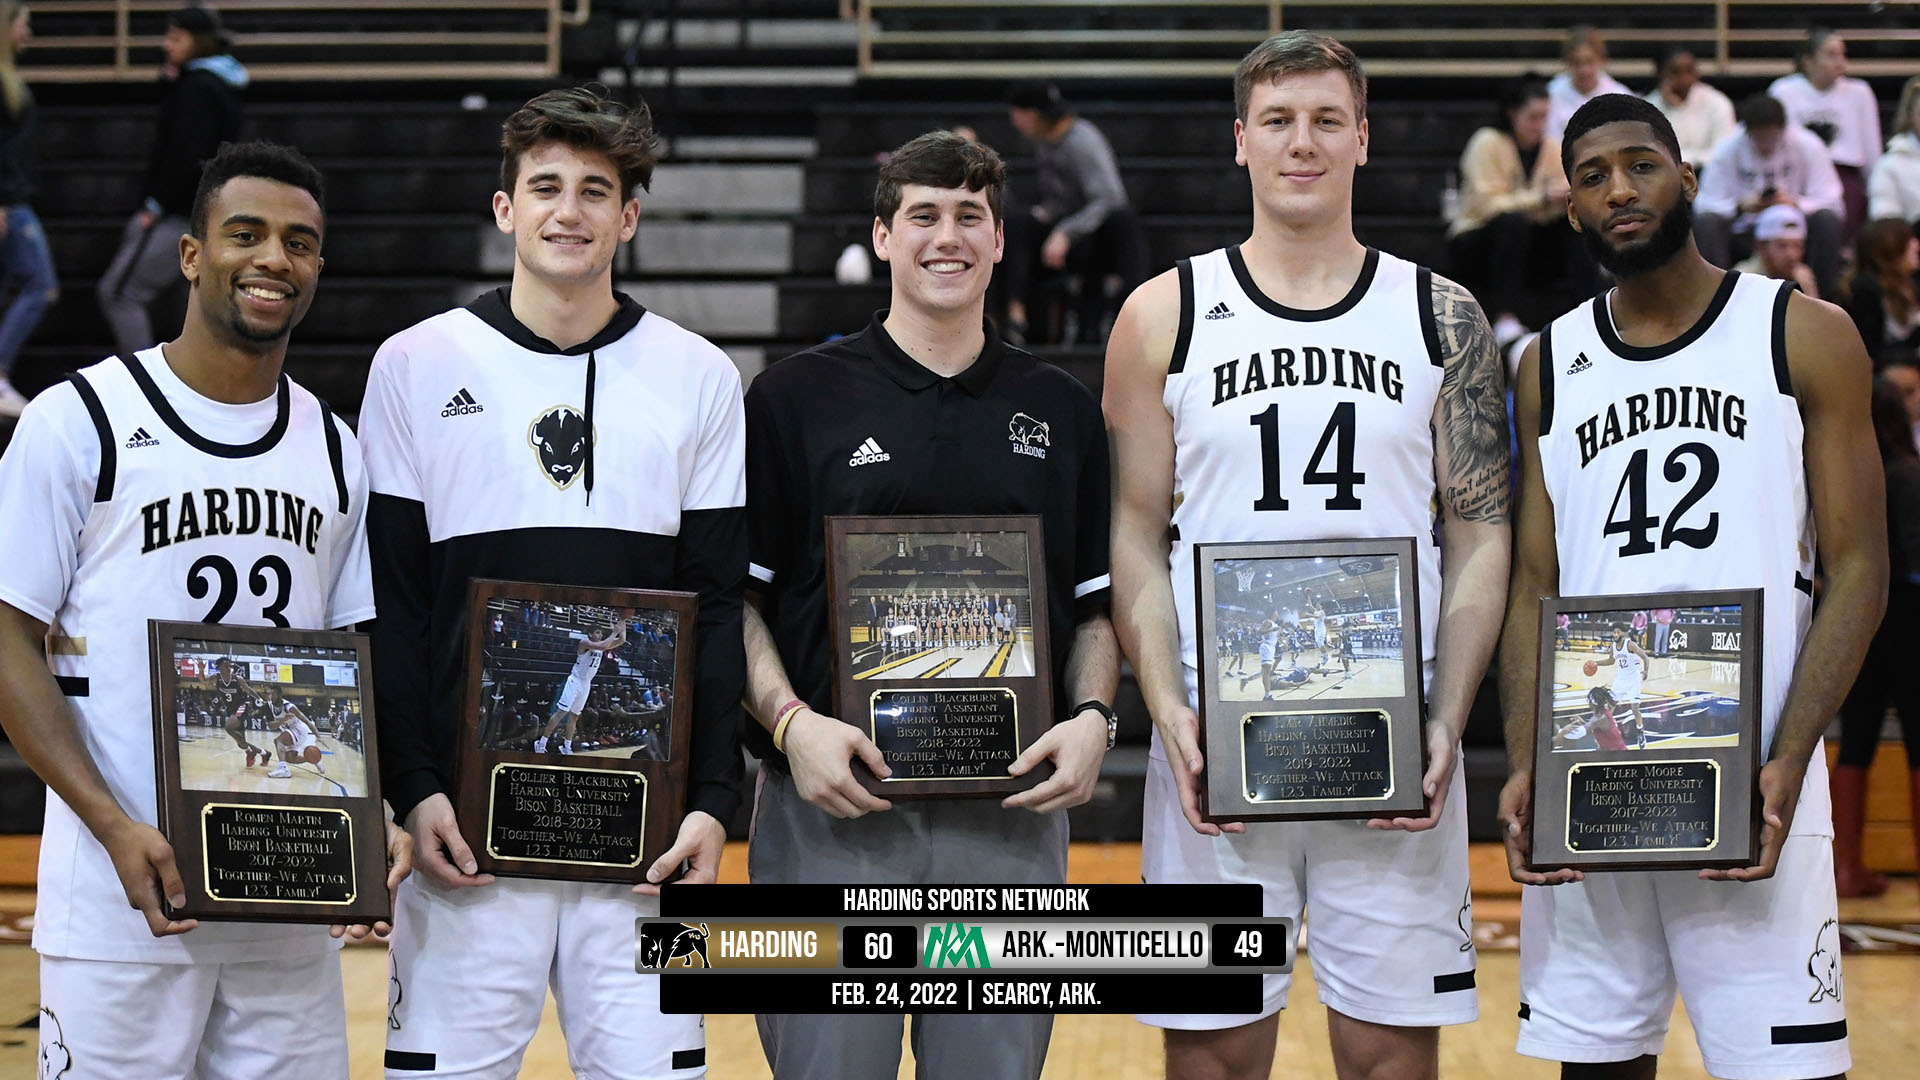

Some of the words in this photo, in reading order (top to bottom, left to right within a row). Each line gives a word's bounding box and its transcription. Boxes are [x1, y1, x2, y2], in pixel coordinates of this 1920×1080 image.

[1205, 312, 1235, 321] adidas
[1566, 361, 1593, 376] adidas
[1212, 346, 1404, 408] HARDING
[441, 403, 484, 418] adidas
[1575, 386, 1747, 470] HARDING
[126, 437, 160, 449] adidas
[1013, 443, 1046, 460] HARDING
[1250, 402, 1366, 512] 14
[849, 452, 890, 467] adidas
[1603, 442, 1720, 558] 42
[140, 487, 324, 555] HARDING
[186, 554, 293, 628] 23
[935, 692, 997, 703] BLACKBURN
[944, 703, 998, 713] ASSISTANT
[945, 713, 1005, 724] UNIVERSITY
[897, 727, 927, 737] BISON
[933, 727, 999, 737] BASKETBALL
[1313, 728, 1375, 740] UNIVERSITY
[916, 738, 981, 748] 2018-2022
[1302, 742, 1370, 755] BASKETBALL
[969, 749, 1011, 760] ATTACK
[1284, 757, 1351, 770] 2019-2022
[511, 770, 556, 785] COLLIER
[563, 773, 629, 788] BLACKBURN
[1340, 770, 1384, 781] ATTACK
[1603, 767, 1638, 778] TYLER
[1644, 766, 1684, 777] MOORE
[510, 783, 560, 798] HARDING
[566, 786, 631, 802] UNIVERSITY
[1585, 780, 1634, 792] HARDING
[1640, 779, 1703, 791] UNIVERSITY
[1591, 794, 1622, 806] BISON
[1628, 792, 1696, 804] BASKETBALL
[515, 797, 547, 813] BISON
[553, 800, 622, 817] BASKETBALL
[1610, 807, 1677, 819] 2017-2022
[235, 810, 274, 823] ROMEN
[279, 812, 322, 825] MARTIN
[533, 815, 602, 830] 2018-2022
[221, 823, 270, 837] HARDING
[276, 825, 338, 840] UNIVERSITY
[1664, 820, 1708, 832] ATTACK
[228, 837, 260, 852] BISON
[265, 838, 333, 854] BASKETBALL
[589, 834, 633, 847] ATTACK
[249, 854, 316, 868] 2017-2022
[304, 871, 347, 884] ATTACK
